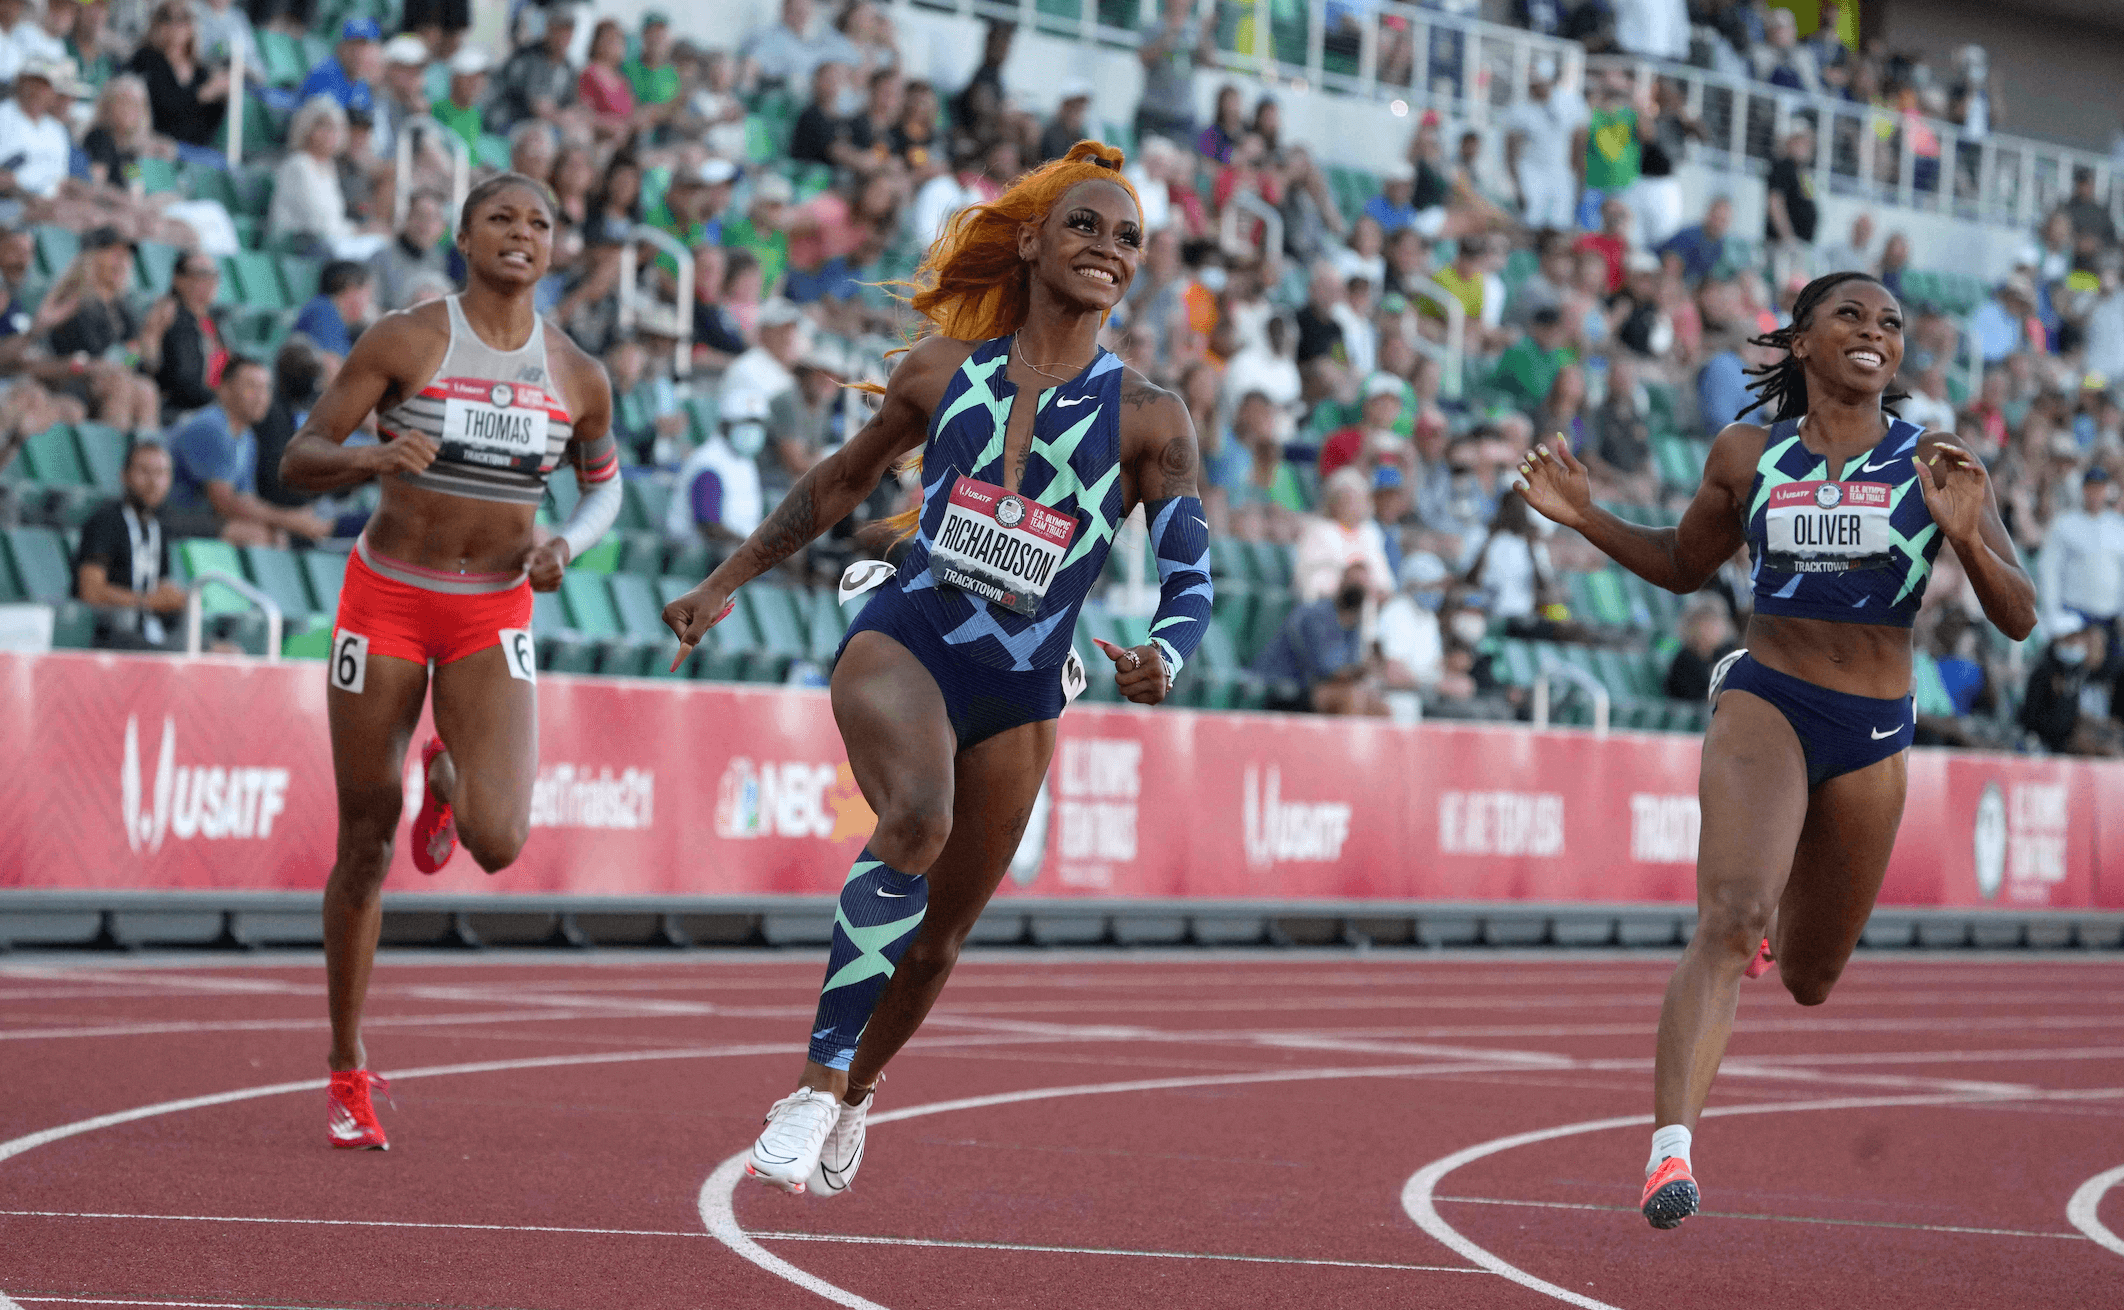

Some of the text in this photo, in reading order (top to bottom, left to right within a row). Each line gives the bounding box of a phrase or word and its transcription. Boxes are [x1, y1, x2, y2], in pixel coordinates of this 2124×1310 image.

[465, 408, 532, 445] THOMAS
[968, 491, 993, 503] USATF
[1030, 517, 1067, 539] TEAM TRIALS
[1033, 508, 1072, 531] U.S. OLYMPIC
[1794, 514, 1861, 546] OLIVER
[939, 514, 1056, 587] RICHARDSON
[338, 636, 358, 686] 6
[514, 632, 534, 677] 6
[171, 765, 290, 840] USATF
